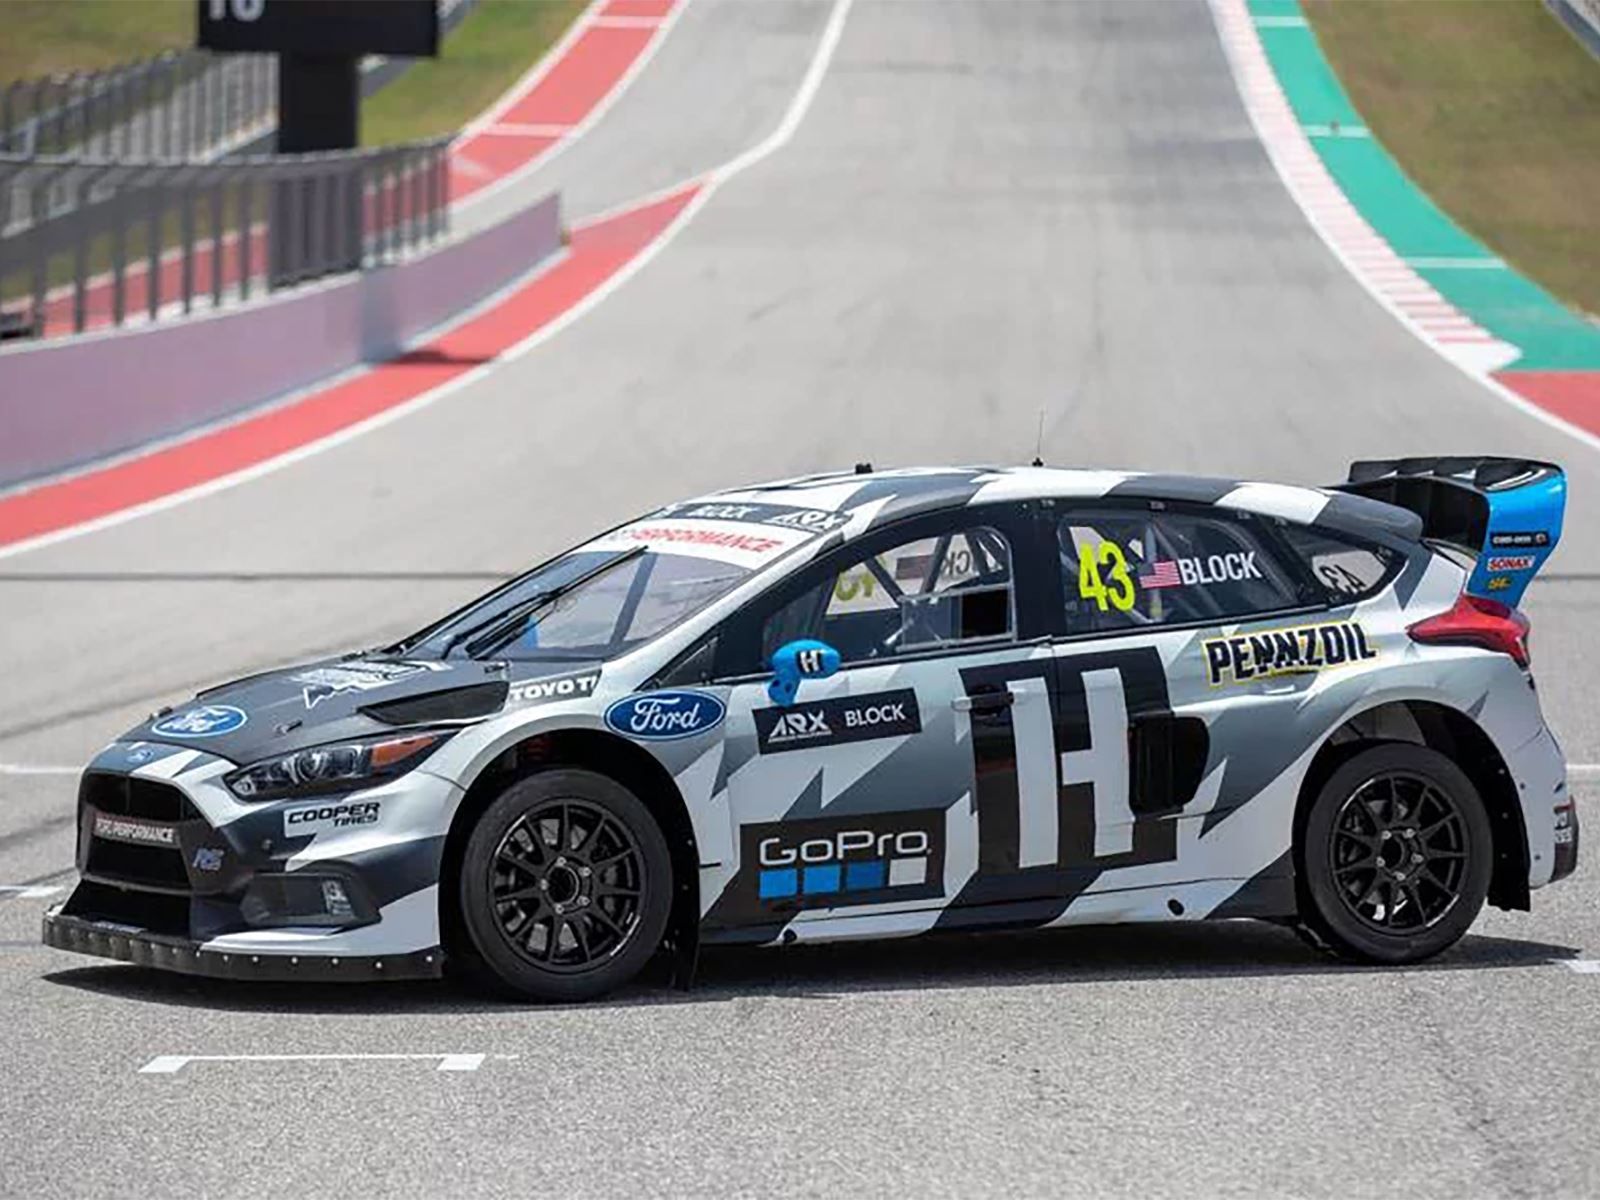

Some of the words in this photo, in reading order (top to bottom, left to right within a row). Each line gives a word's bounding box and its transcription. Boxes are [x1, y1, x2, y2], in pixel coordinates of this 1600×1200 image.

[1078, 540, 1135, 612] 43
[1178, 551, 1262, 585] BLOCK
[1204, 622, 1378, 685] PENNZOIL
[509, 679, 575, 701] TOYO
[630, 697, 701, 732] Ford
[769, 709, 830, 738] ARX
[845, 703, 907, 728] BLOCK
[288, 802, 381, 824] COOPER
[333, 814, 379, 827] TIRES
[759, 830, 927, 866] GoPro
